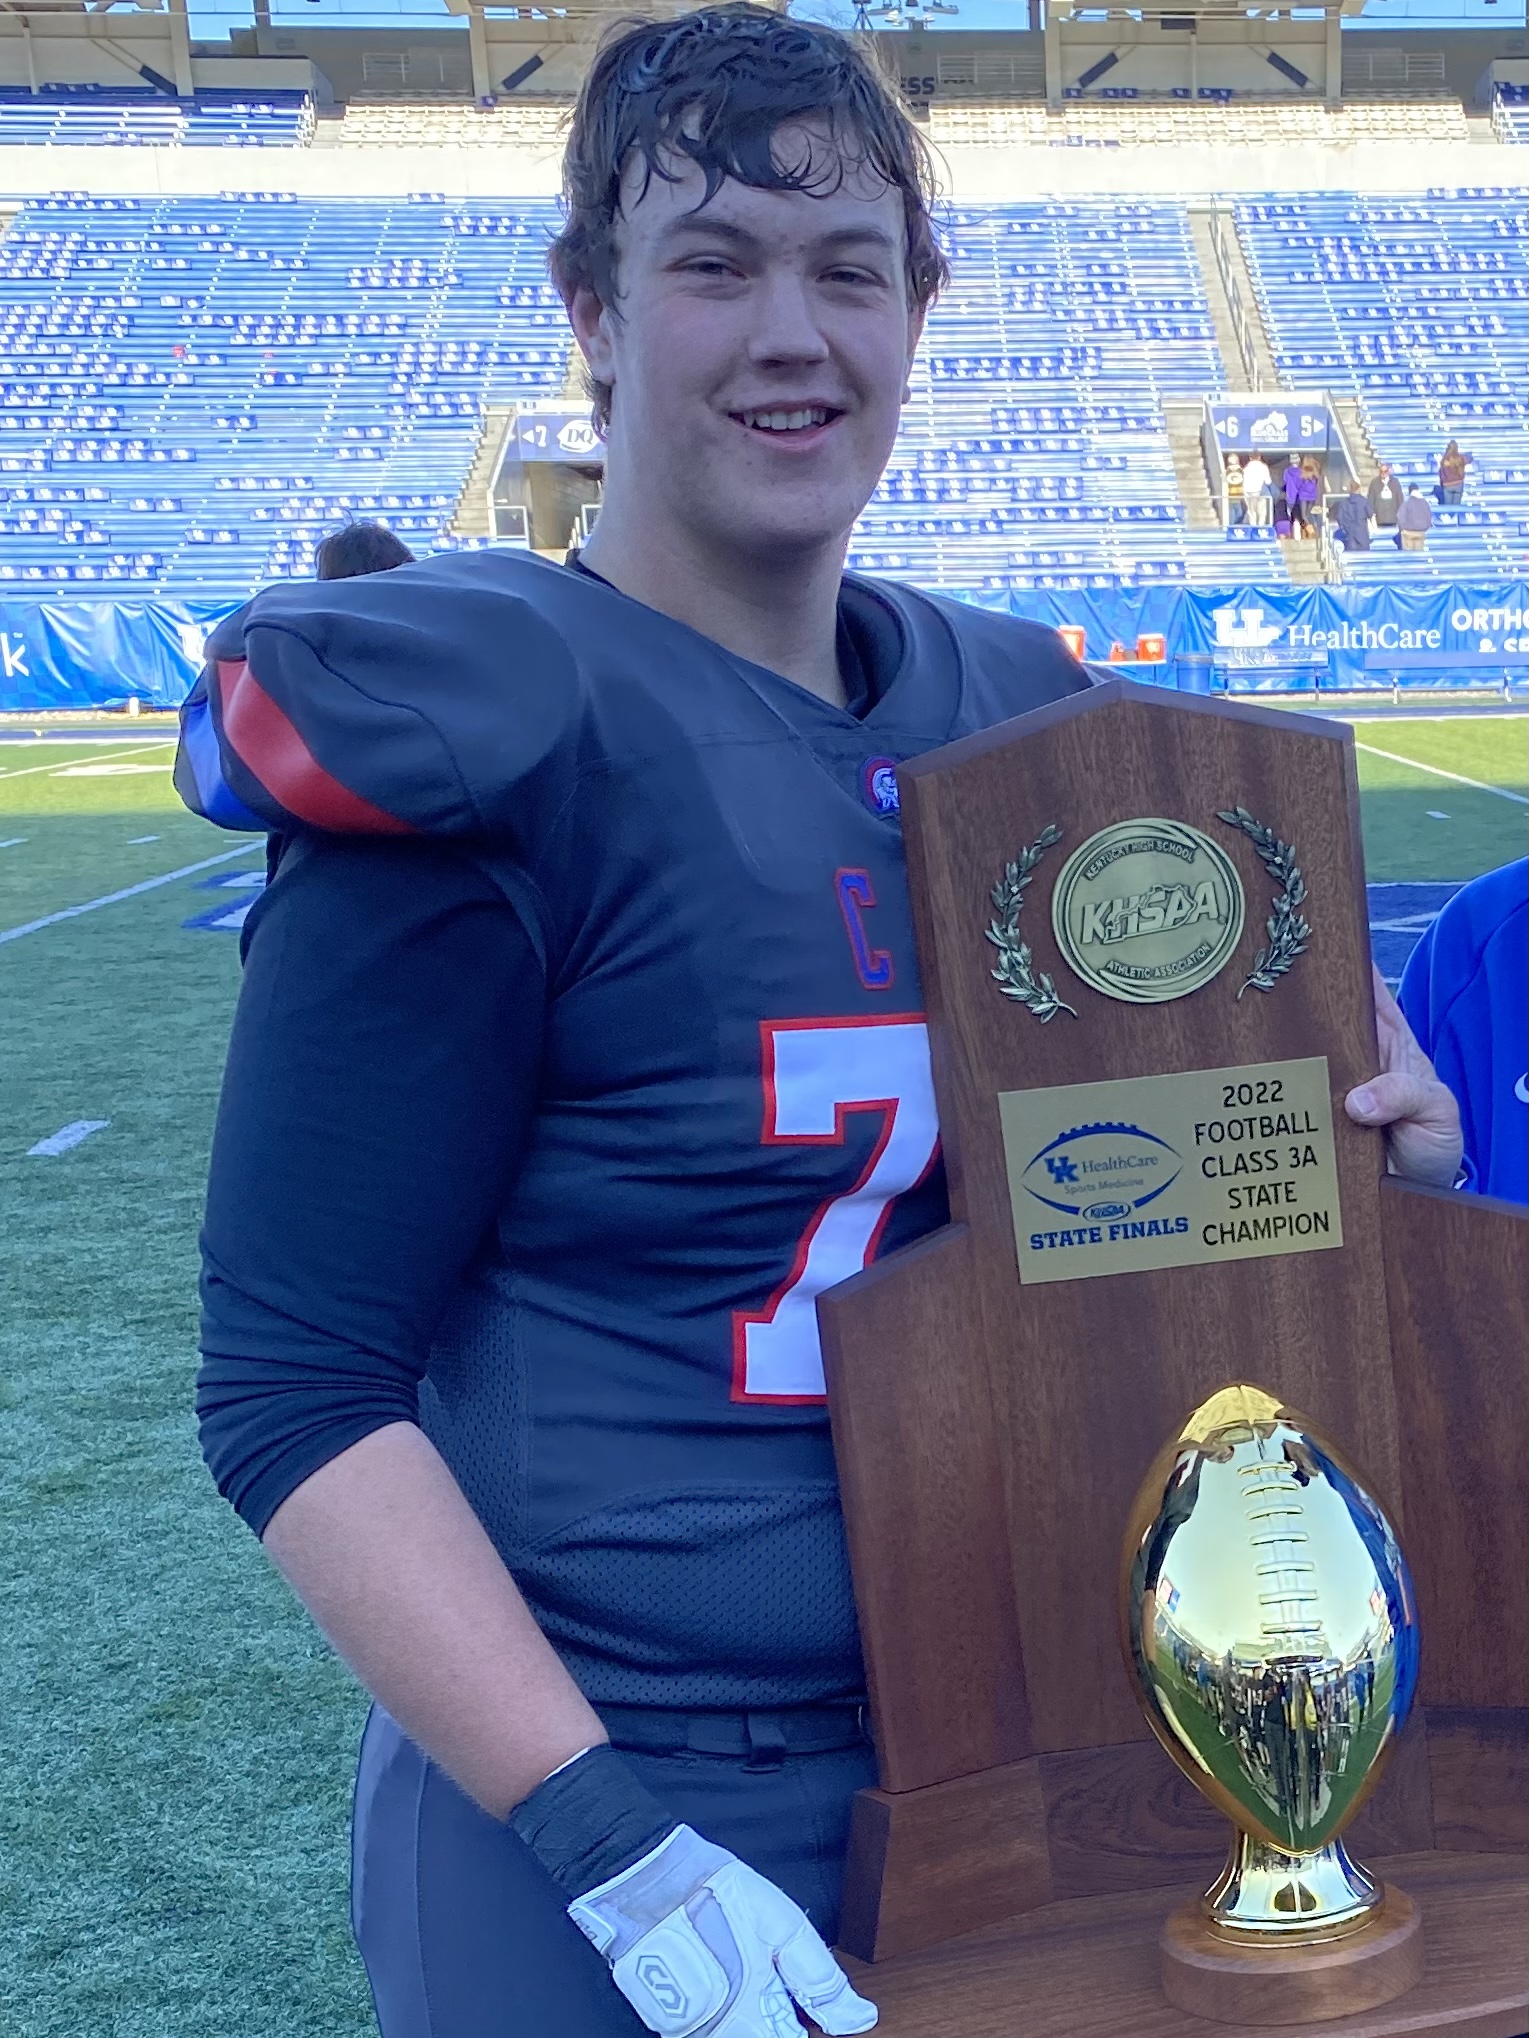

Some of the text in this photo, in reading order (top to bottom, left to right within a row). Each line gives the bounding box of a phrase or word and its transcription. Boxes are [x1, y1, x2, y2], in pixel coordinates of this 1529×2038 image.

[535, 425, 548, 448] 7
[567, 428, 594, 444] DQ
[1226, 416, 1239, 438] 6
[1301, 415, 1312, 437] 5
[1287, 619, 1441, 650] HealthCare
[1085, 839, 1195, 880] KENTUCKY HIGH SCHOOL
[1081, 881, 1219, 944] KHSAA
[835, 867, 895, 990] C
[1105, 942, 1211, 979] ATHLETIC ASSOCIATION
[1222, 1080, 1284, 1108] 2022
[1194, 1110, 1319, 1147] FOOTBALL
[1044, 1155, 1159, 1184] UK HealthCare
[1201, 1145, 1318, 1179] CLASS 3A
[1064, 1178, 1145, 1196] Sports Medicine
[1227, 1181, 1298, 1210] STATE
[1030, 1217, 1189, 1250] STATE FINALS
[1202, 1210, 1330, 1246] CHAMPION
